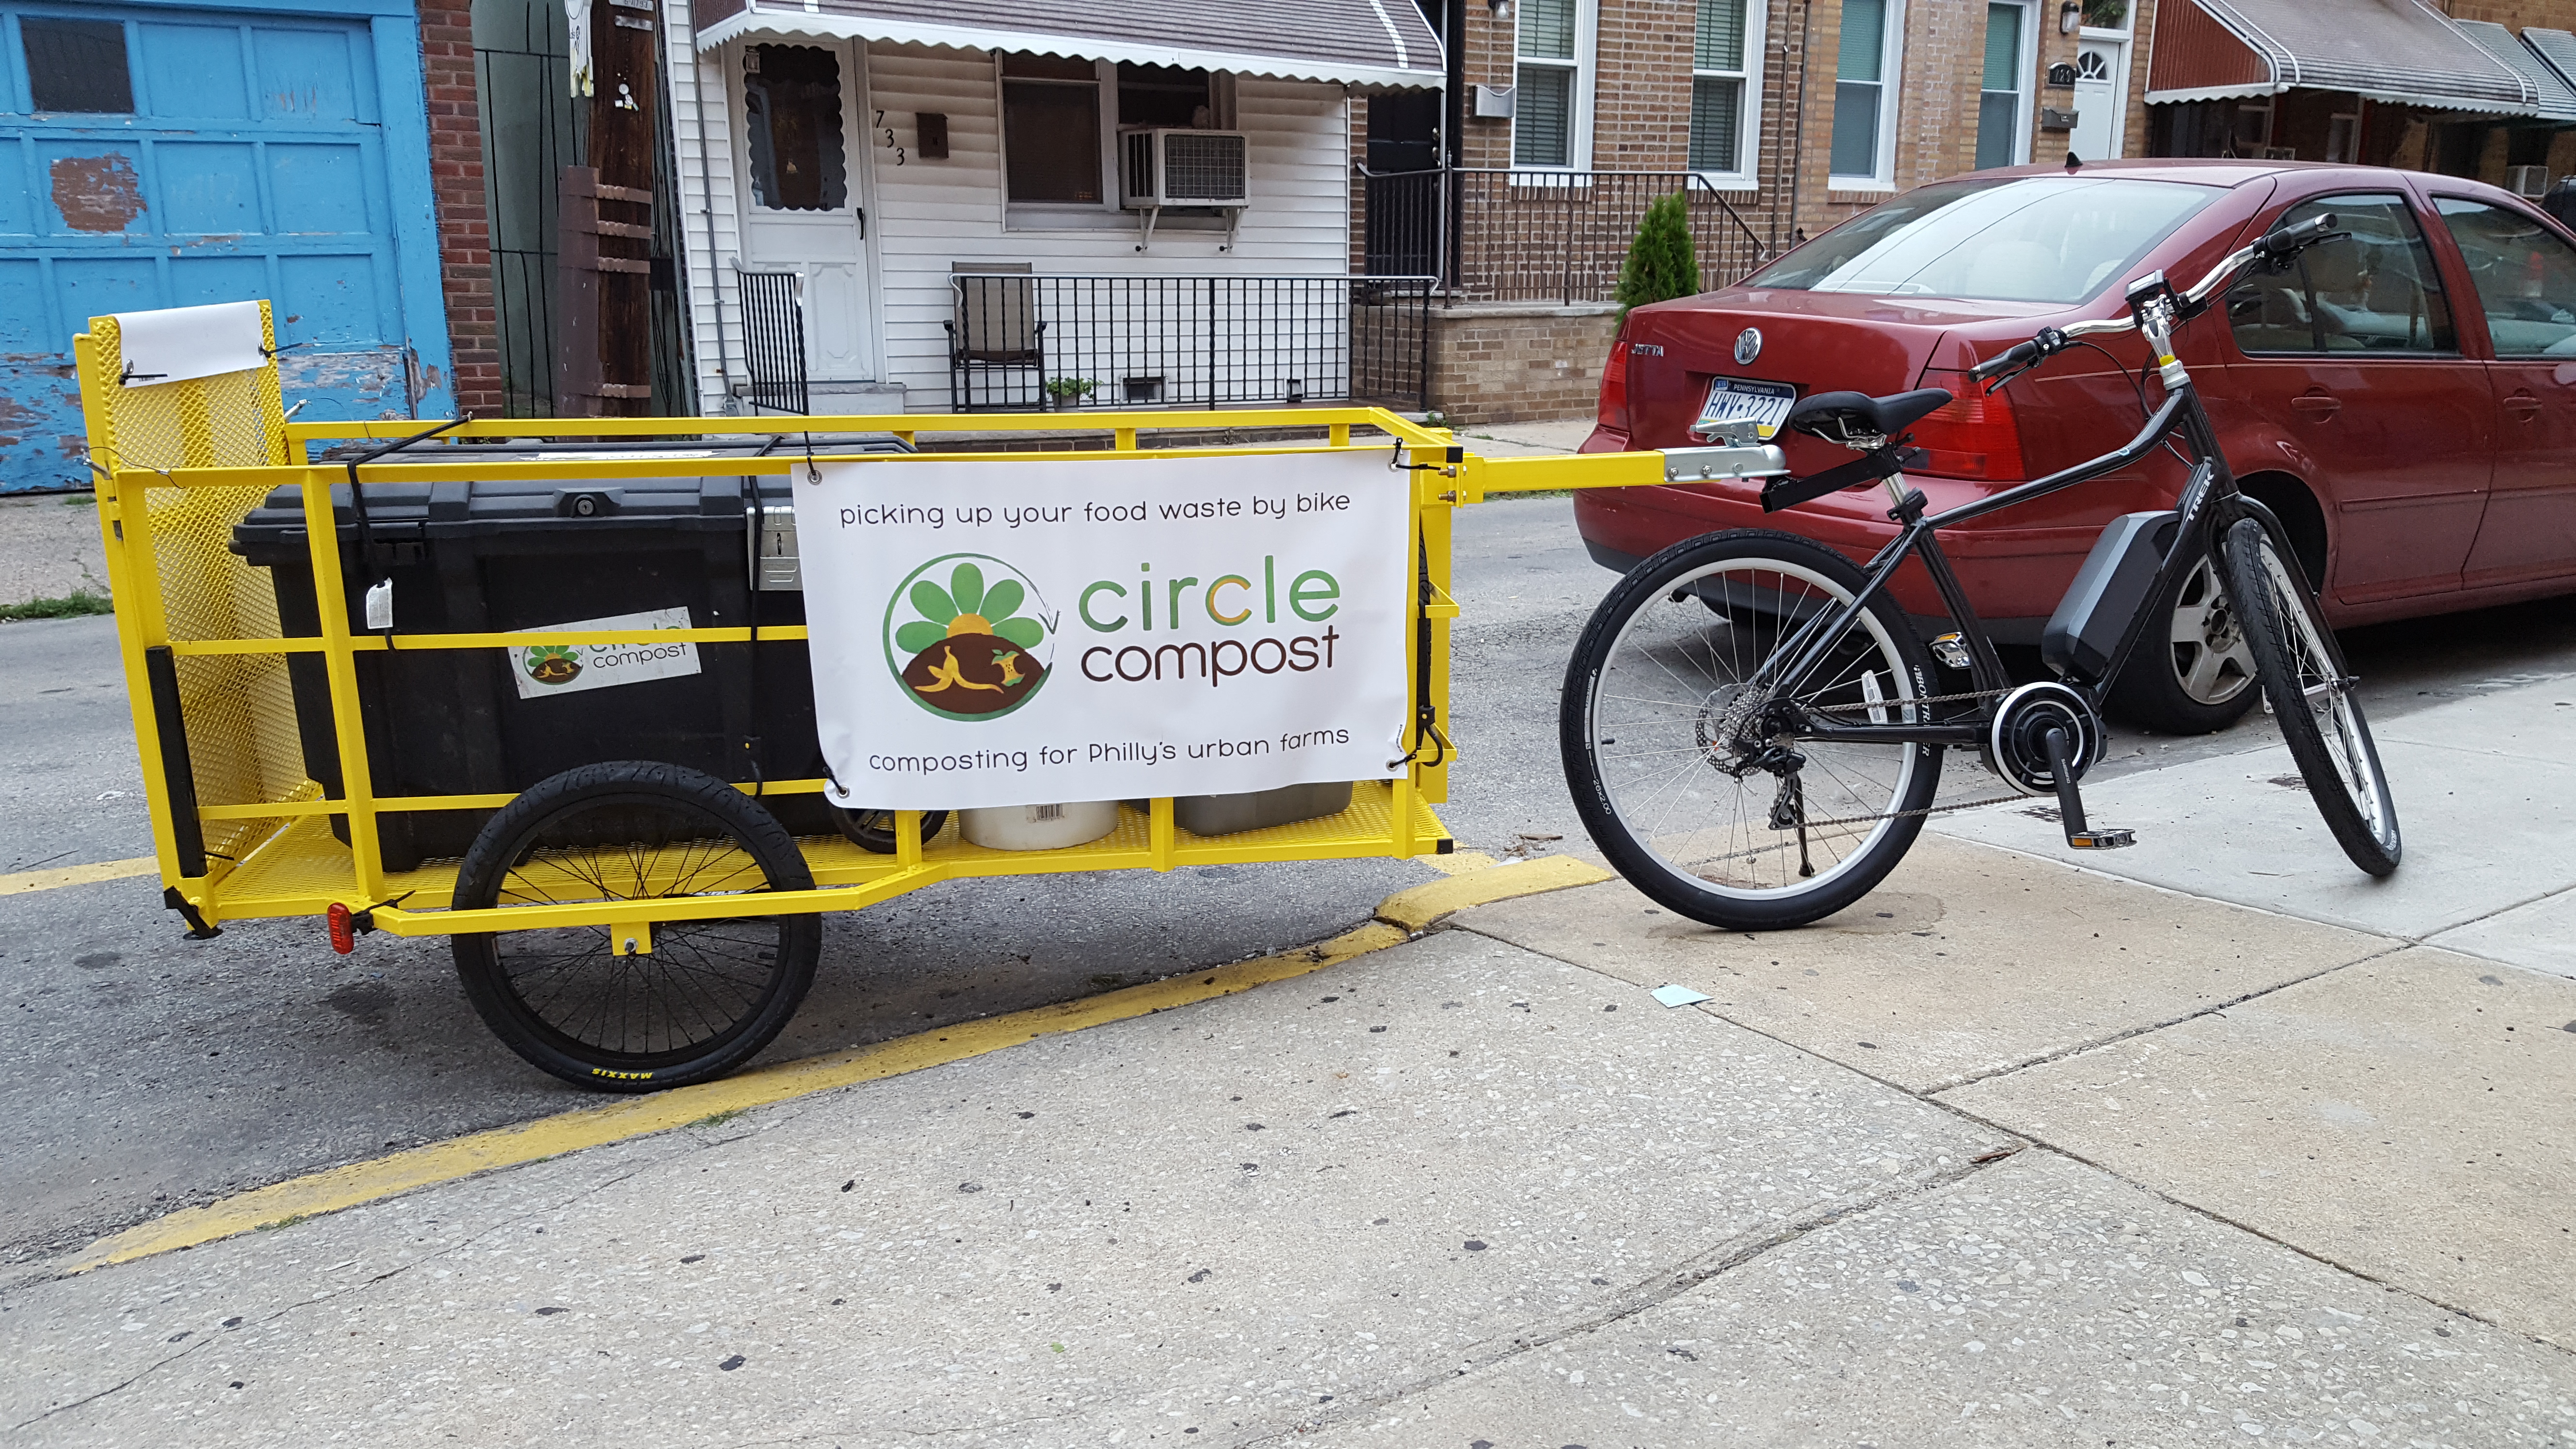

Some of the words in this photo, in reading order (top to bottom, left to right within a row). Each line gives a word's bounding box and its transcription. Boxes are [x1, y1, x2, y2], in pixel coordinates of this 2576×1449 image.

[876, 110, 904, 165] 733
[1631, 343, 1664, 357] JETTA
[1733, 384, 1775, 395] PENNSYLVANIA
[840, 504, 944, 529] picking
[956, 506, 993, 527] up
[1003, 506, 1072, 529] your
[1084, 501, 1147, 522] food
[1159, 498, 1241, 520] waste
[1253, 496, 1286, 519] by
[1297, 492, 1351, 513] bike
[2185, 470, 2215, 522] TREK
[1079, 554, 1340, 633] circle
[593, 642, 687, 669] compost
[1080, 625, 1340, 688] compost
[1916, 678, 1931, 757] BONTRER
[869, 749, 1028, 775] composting
[1039, 745, 1078, 766] for
[1089, 741, 1176, 766] Philly's
[1188, 739, 1270, 759] urban
[1279, 728, 1350, 752] farms
[1593, 779, 1612, 815] 26x2.00
[592, 1068, 653, 1079] MAXXIS
